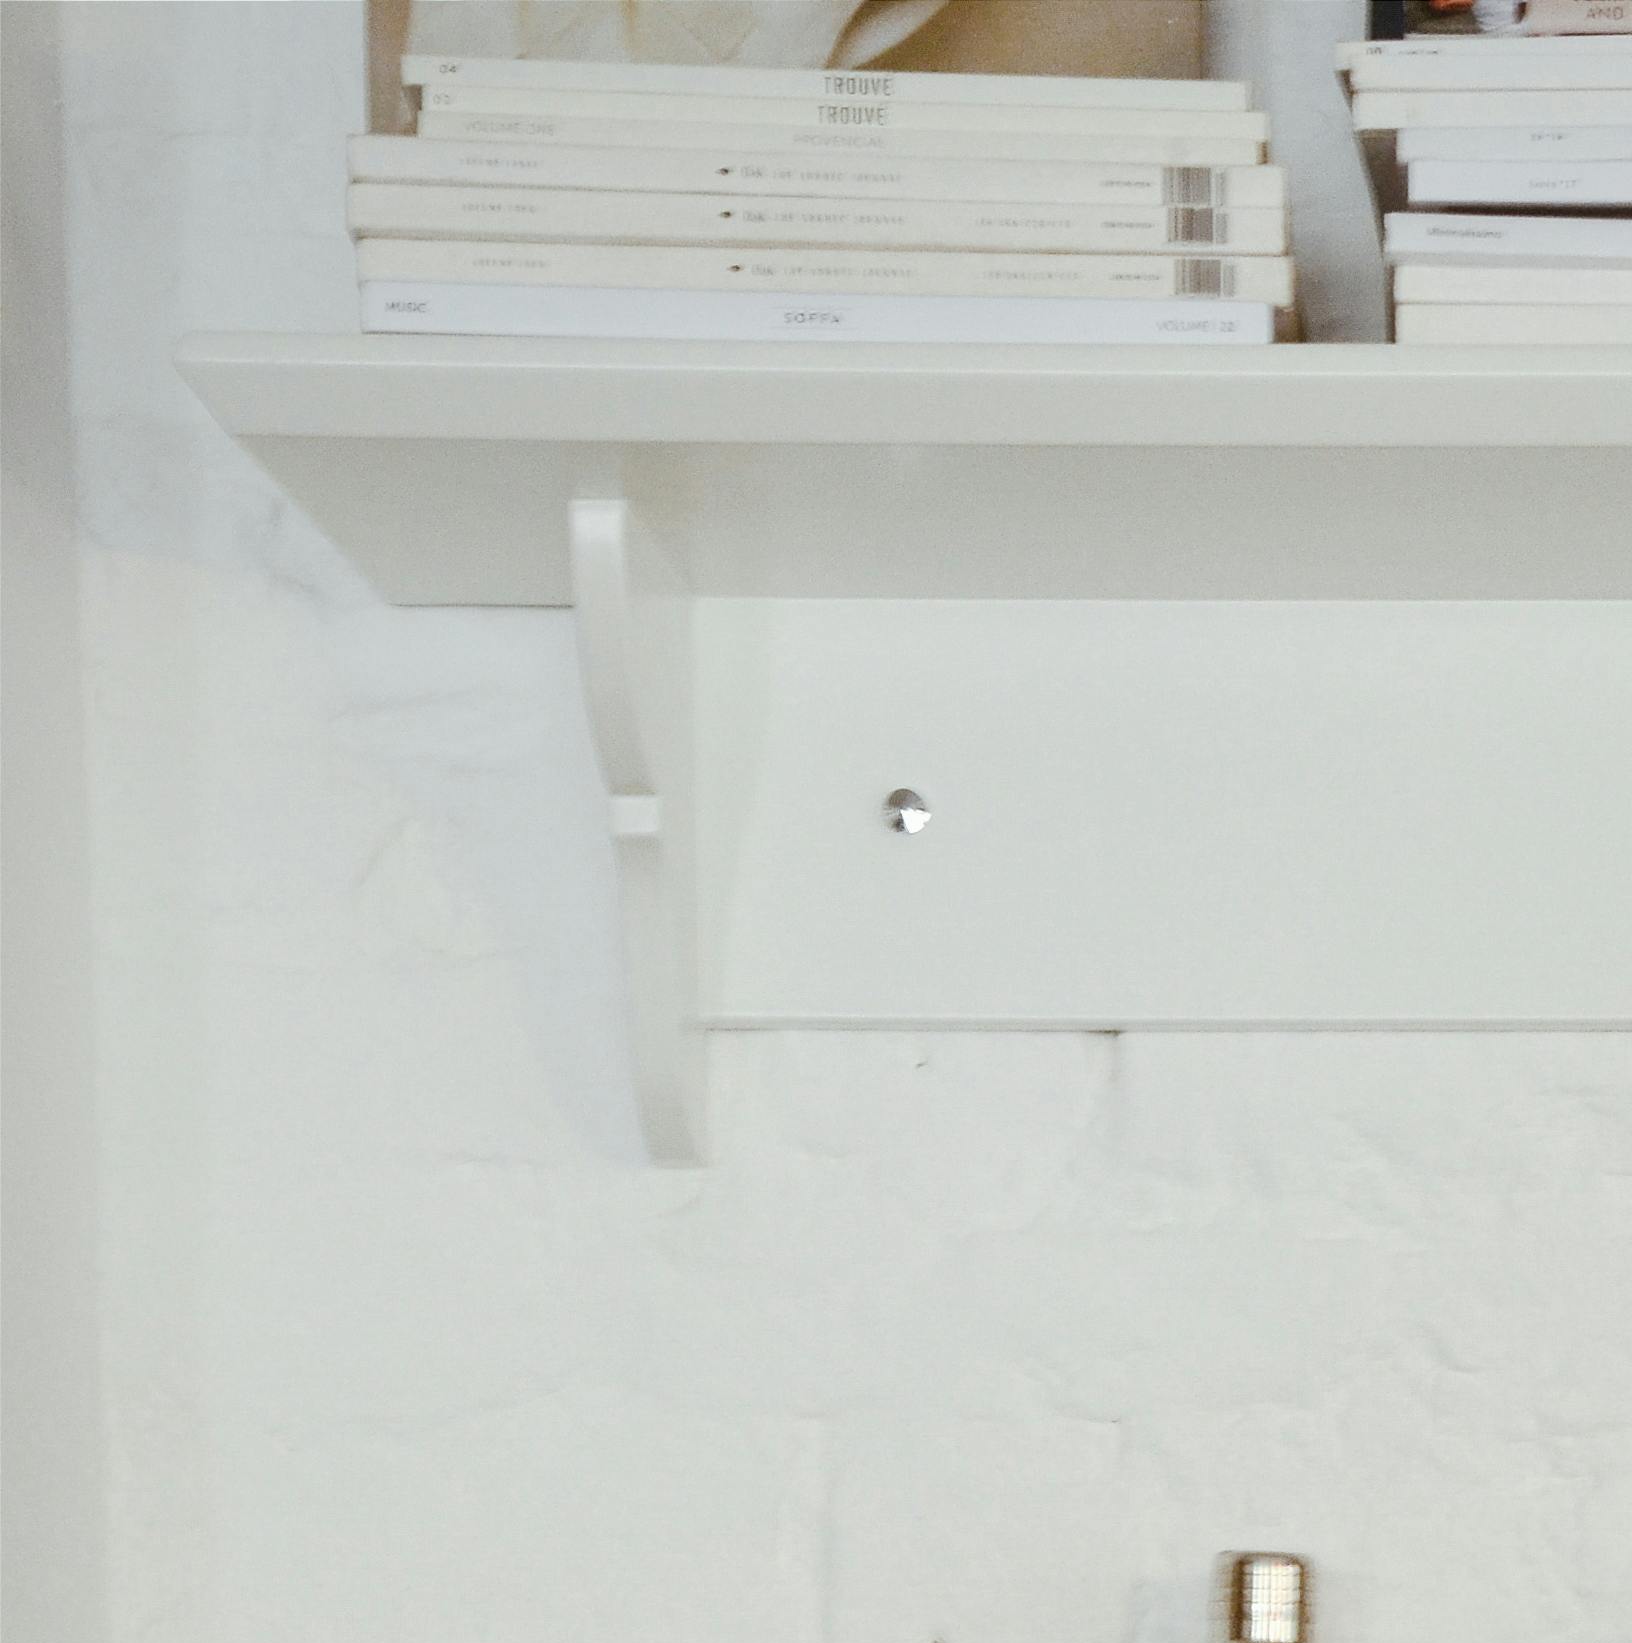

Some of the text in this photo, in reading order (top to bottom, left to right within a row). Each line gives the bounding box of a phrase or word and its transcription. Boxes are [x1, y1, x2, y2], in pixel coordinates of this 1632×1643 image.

[1586, 7, 1623, 20] AND
[824, 77, 893, 96] TROUVE
[817, 105, 886, 126] TROUVE
[385, 300, 428, 313] MUSIC
